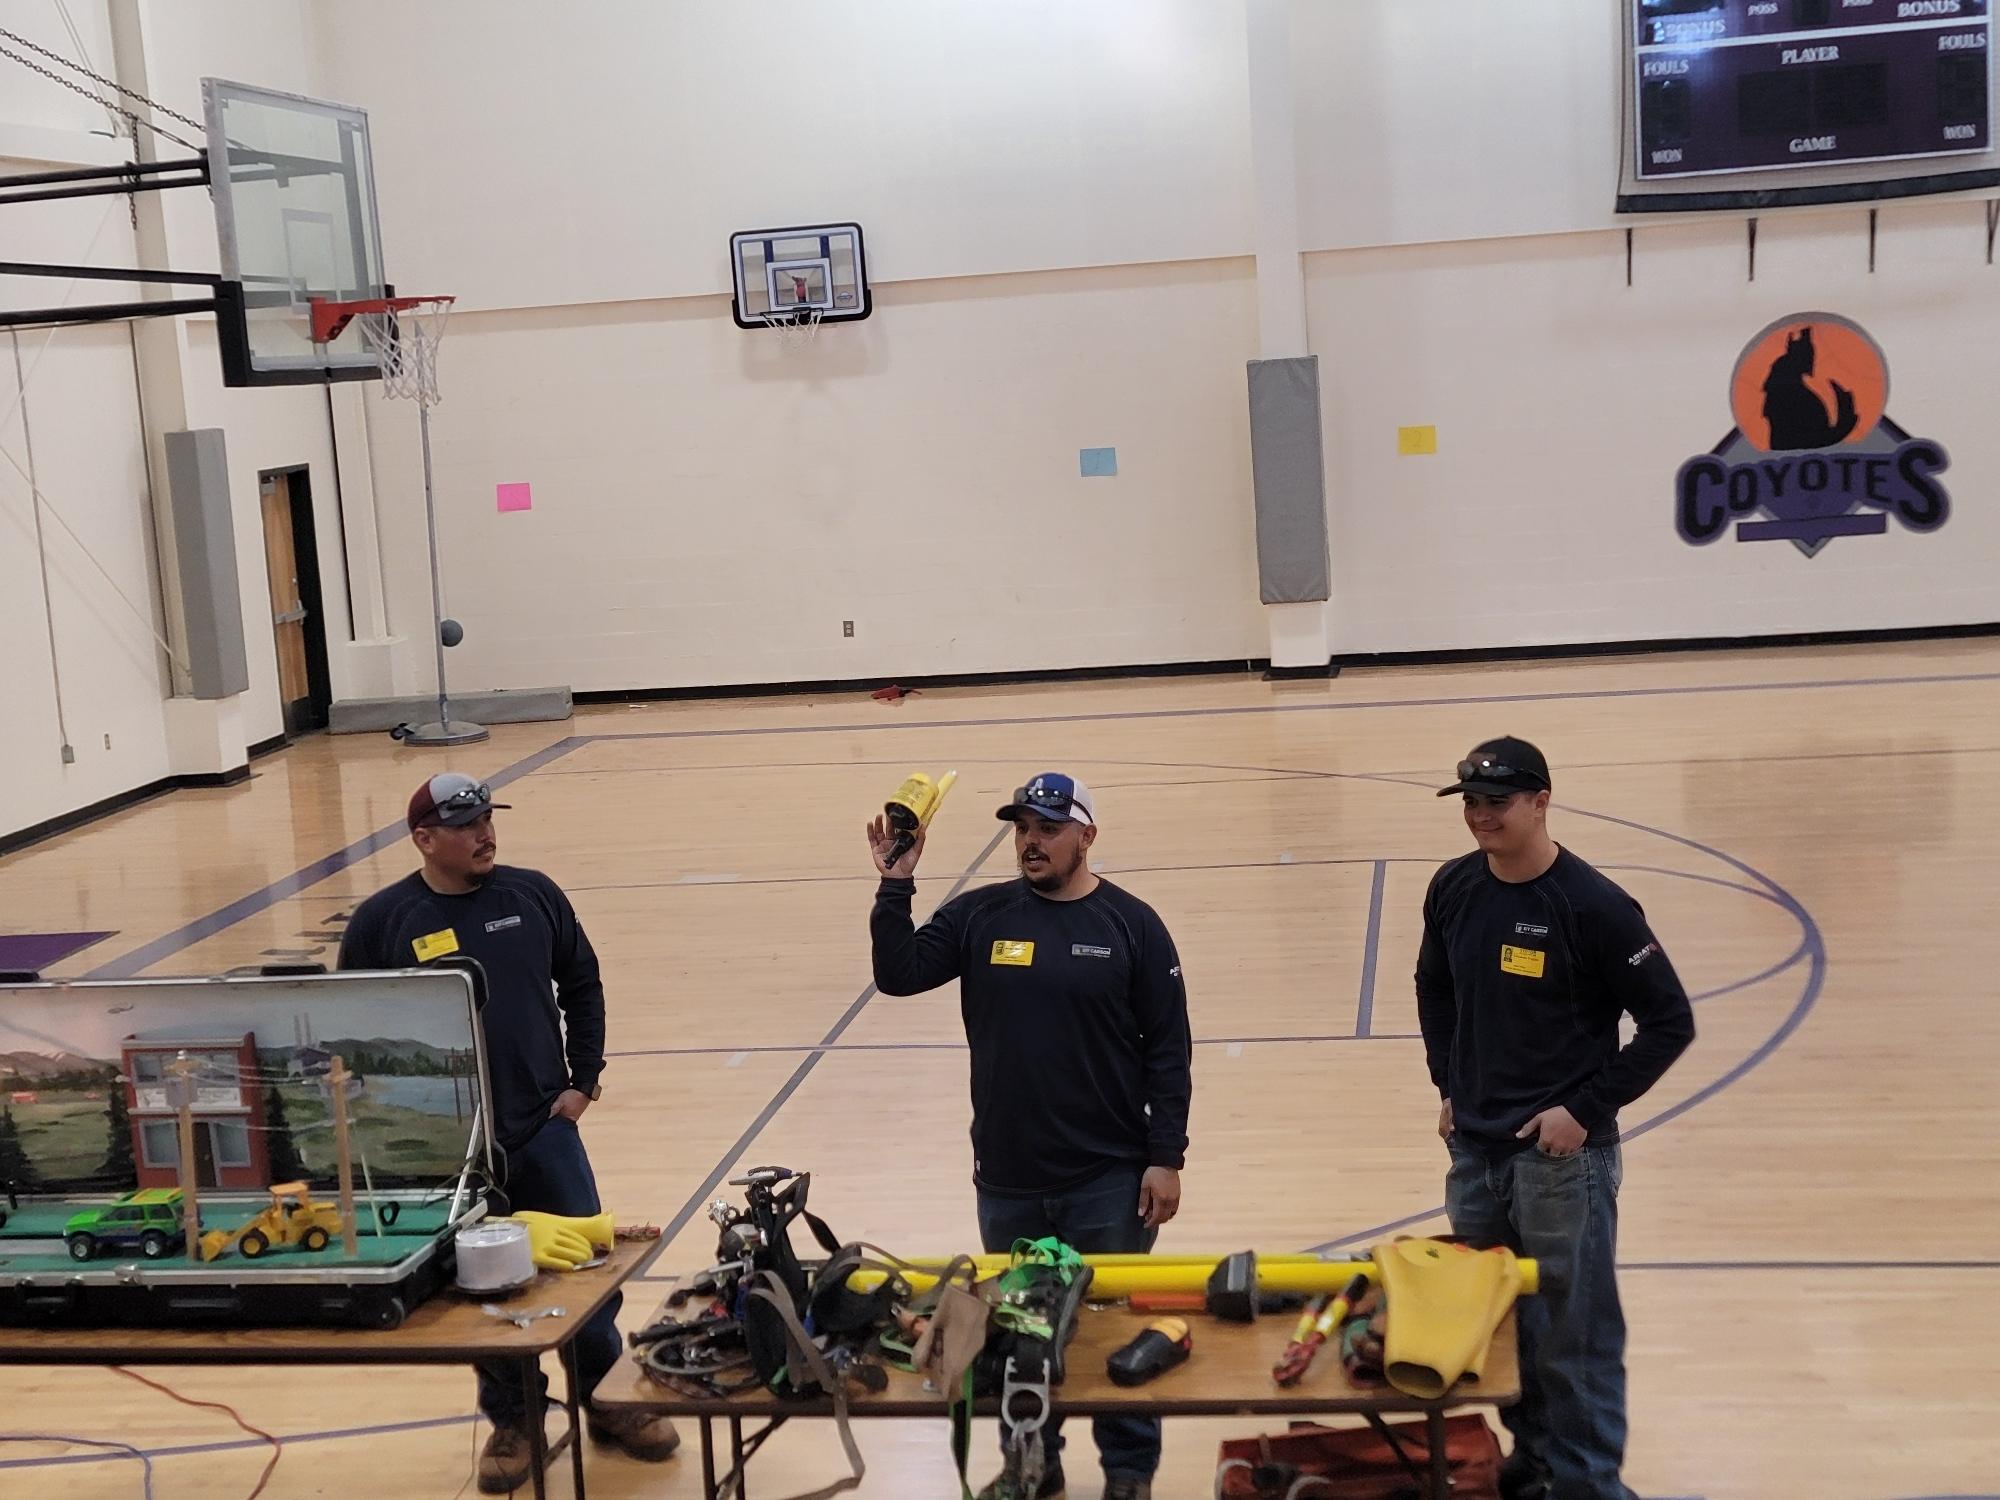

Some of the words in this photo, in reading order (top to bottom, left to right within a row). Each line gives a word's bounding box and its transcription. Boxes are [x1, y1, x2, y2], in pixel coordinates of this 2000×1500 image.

[1748, 3, 1778, 16] POSS
[1897, 0, 1961, 18] BONUS
[1665, 19, 1726, 37] BONUS
[1938, 33, 1986, 50] FOULS
[1781, 45, 1840, 65] PLAYER
[1643, 59, 1690, 76] FOULS
[1943, 123, 1976, 140] WON
[1788, 135, 1837, 153] GAME
[1651, 147, 1683, 164] WON
[1679, 440, 1947, 542] COYOTES
[1628, 944, 1651, 964] ARIAT
